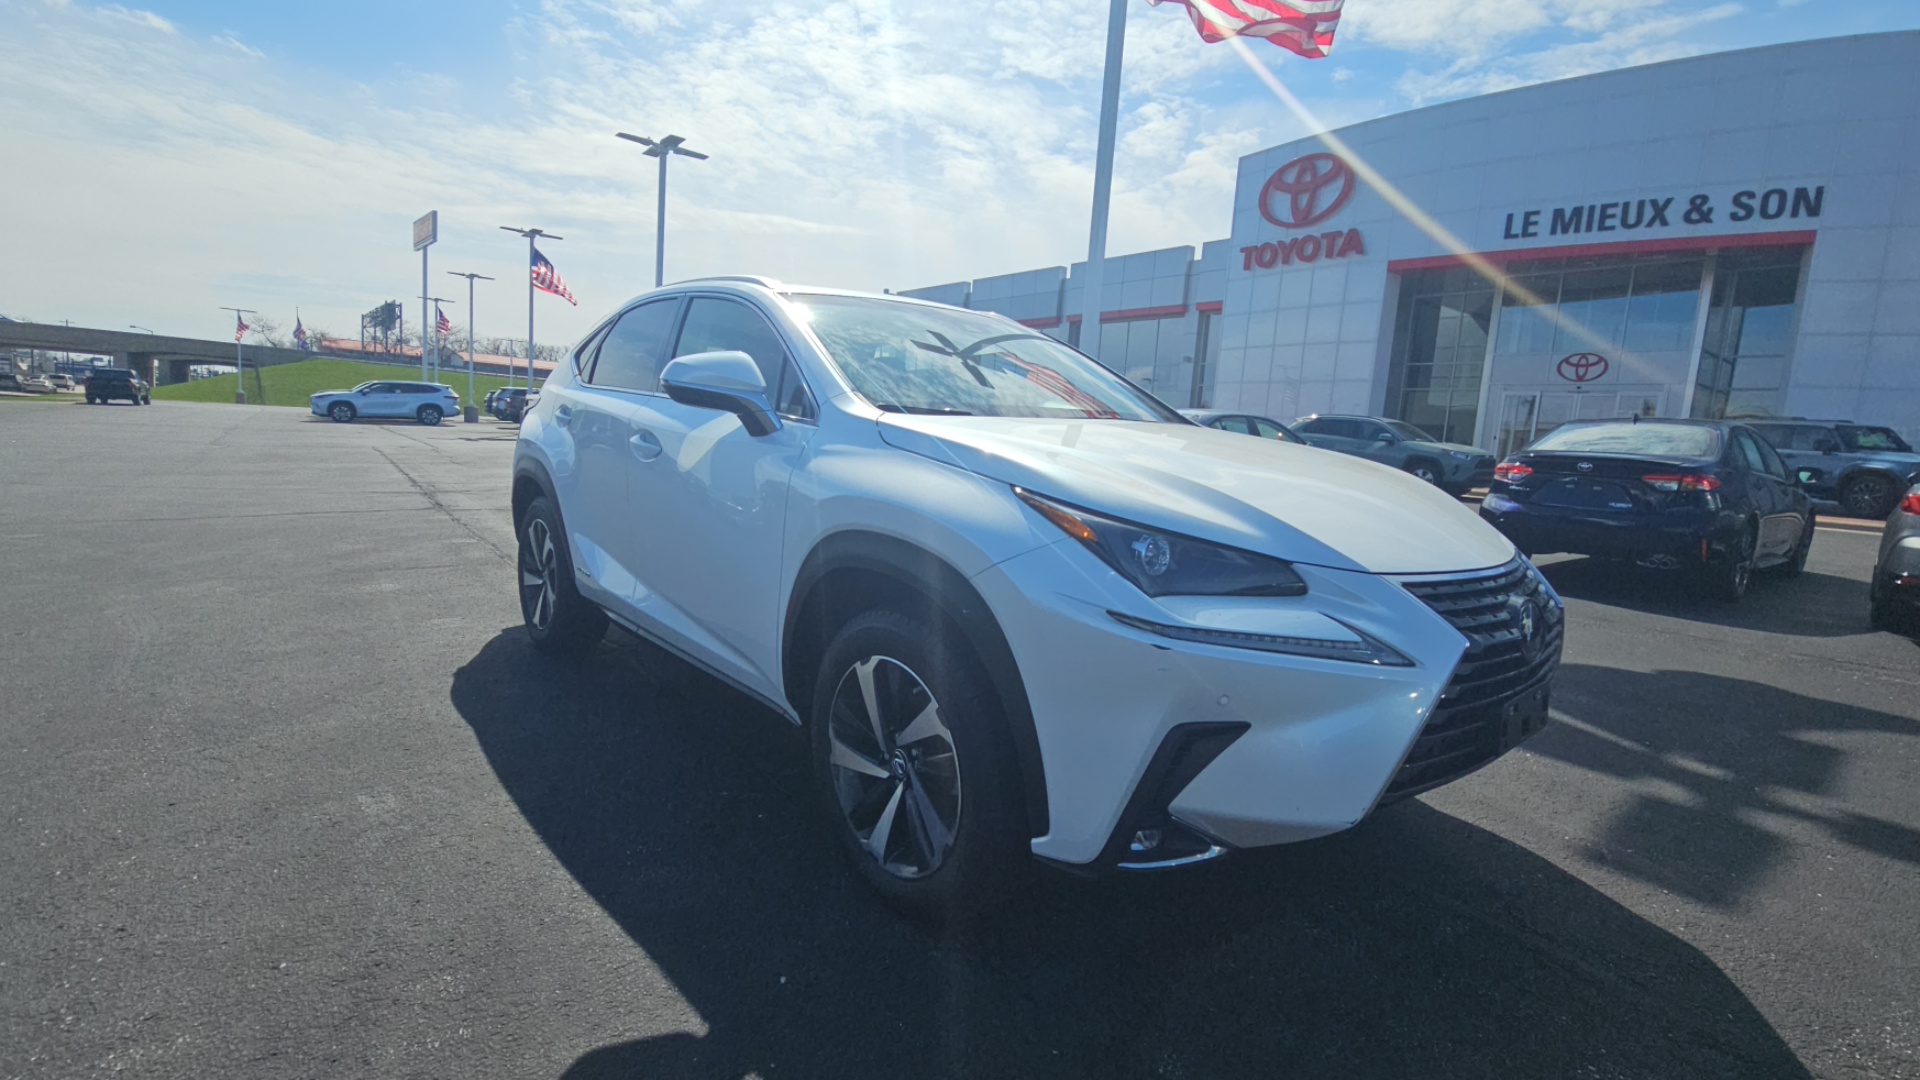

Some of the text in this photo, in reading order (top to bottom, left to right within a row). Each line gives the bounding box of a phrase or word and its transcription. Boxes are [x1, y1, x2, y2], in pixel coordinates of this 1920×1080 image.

[1503, 186, 1825, 239] LE MIEUX & SON
[1240, 228, 1364, 271] TOYOTA
